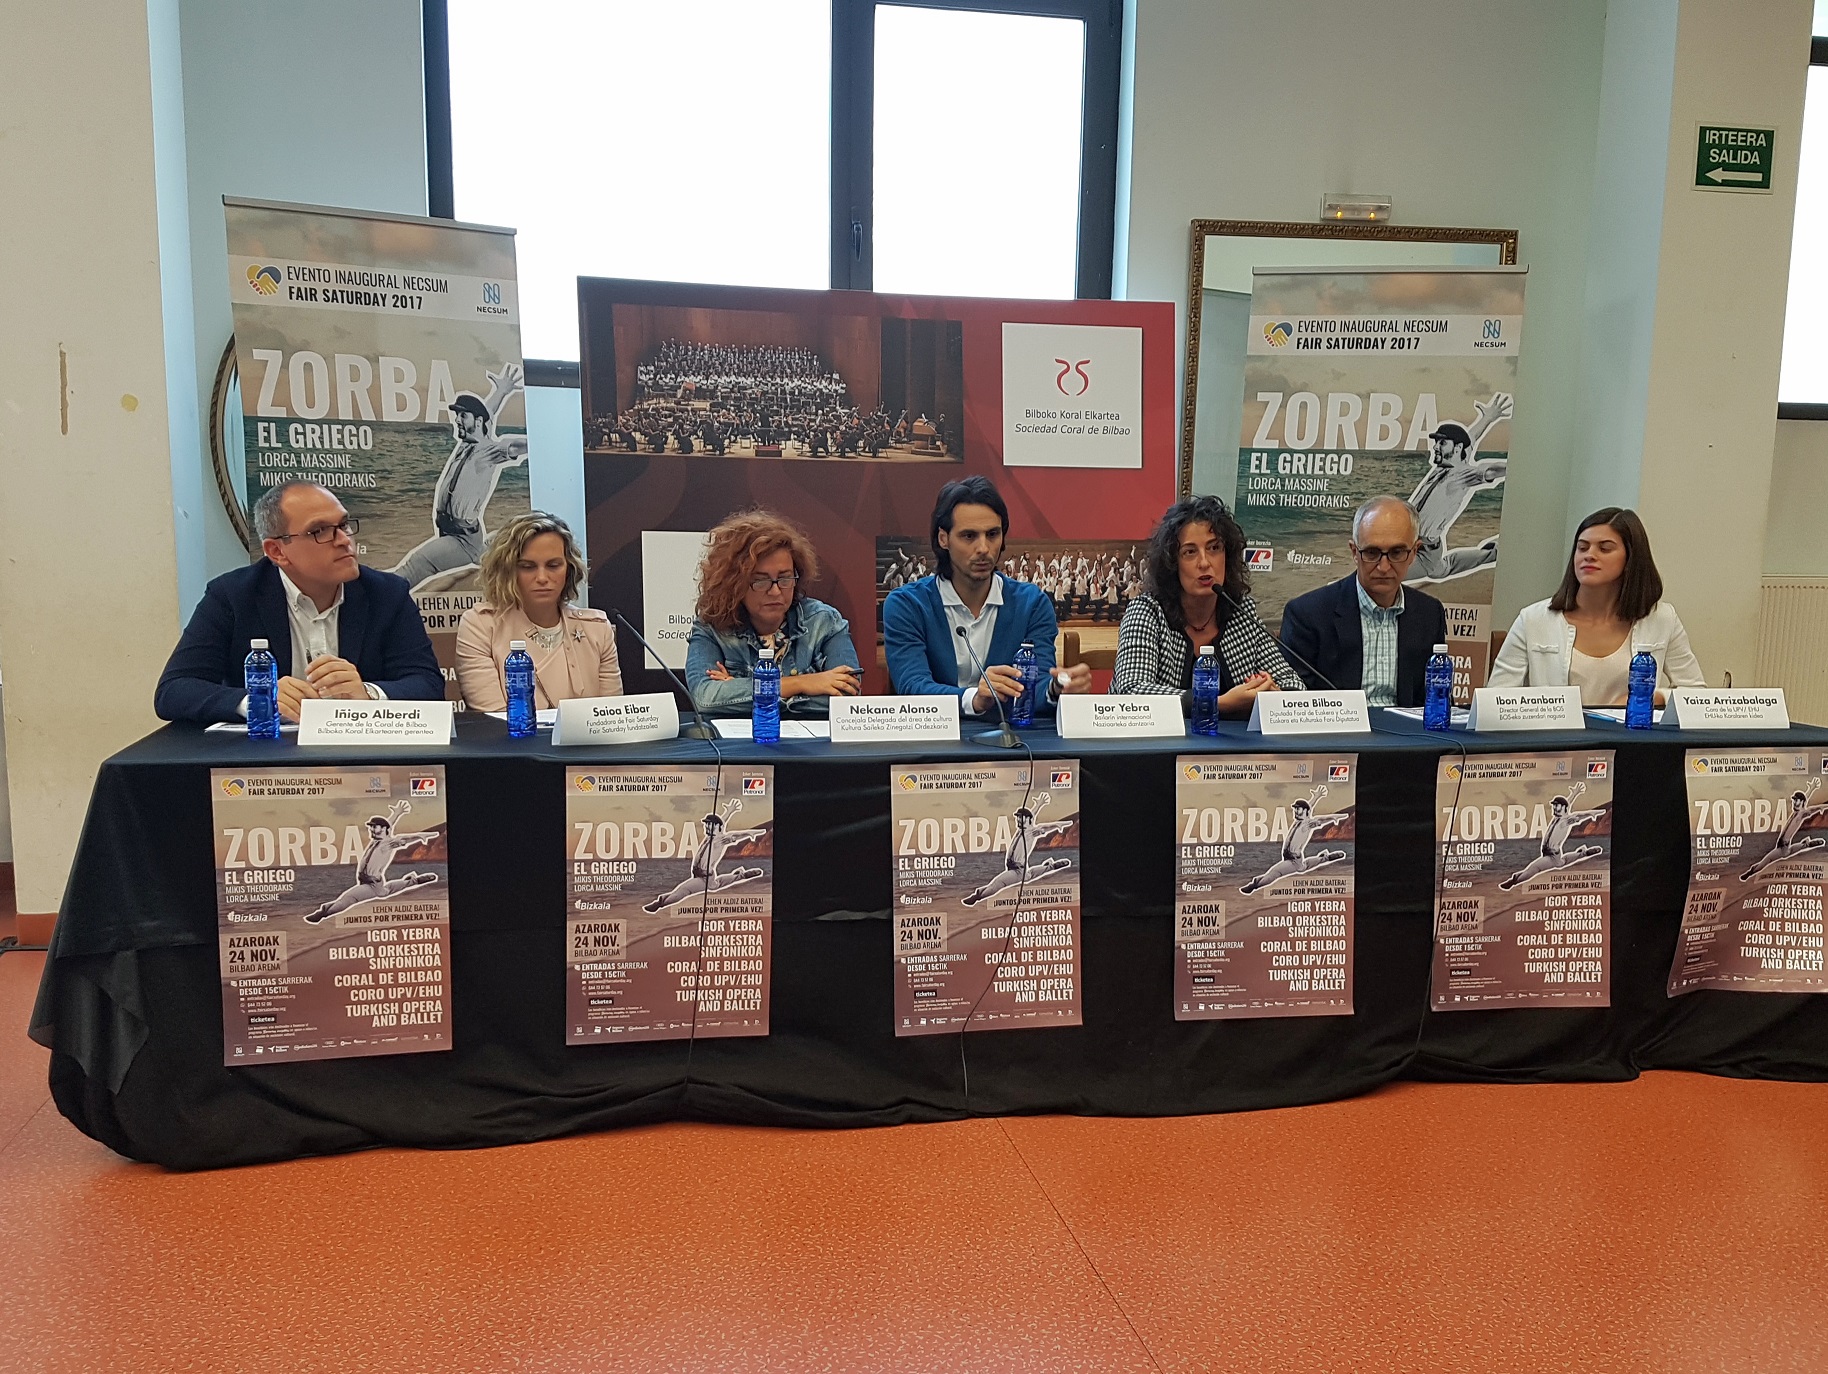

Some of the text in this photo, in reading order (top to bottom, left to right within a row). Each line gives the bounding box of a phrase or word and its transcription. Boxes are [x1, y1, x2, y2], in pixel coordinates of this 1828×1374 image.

[1705, 130, 1766, 147] IRTEERA
[1709, 149, 1760, 165] SALIDA
[287, 266, 449, 293] EVENTO INAUGURAL NECSUM
[289, 286, 423, 310] FAIR SATURDAY 2017
[477, 306, 508, 314] NECSUM
[1298, 320, 1448, 333] EVENTO INAUGURAL NECSUM
[1296, 338, 1420, 350] FAIR SATURDAY 2017
[252, 348, 458, 423] ZORBA
[1025, 409, 1120, 421] Bilboko Koral Elkartea
[1252, 392, 1440, 450] ZORBA
[258, 422, 372, 449] EL GRIEGO
[1015, 424, 1130, 435] Sociedad Coral de Bilbao
[259, 453, 352, 468] LORCA MASSINE
[1250, 452, 1353, 475] EL GRIEGO
[1248, 478, 1329, 491] LORCA MASSINE
[1248, 494, 1350, 508] MIKIS THEODORAKIS
[1294, 554, 1331, 565] Bizkaia
[417, 598, 450, 611] LEHEN
[668, 615, 694, 624] Bilbo
[1444, 608, 1478, 620] ATERA!
[422, 616, 445, 628] POR
[658, 630, 692, 639] Socied
[1453, 625, 1476, 636] VEZ!
[1282, 699, 1342, 708] Lorea Bilbao
[1496, 695, 1565, 705] Ibon Aranbarri
[1683, 696, 1777, 706] Yaiza Arrizabalaga
[593, 704, 650, 717] Saioa Eibar
[850, 704, 938, 714] Nekane Alonso
[1094, 703, 1150, 714] Igor Yebra
[334, 709, 420, 721] Iñigo Alberdi
[248, 788, 265, 796] FAIR
[1695, 799, 1791, 834] ZORBA
[1182, 807, 1289, 843] ZORBA
[574, 822, 700, 859] ZORBA
[899, 817, 1013, 855] ZORBA
[1710, 836, 1742, 848] GRIEGO
[223, 826, 365, 868] ZORBA
[1196, 845, 1234, 857] GRIEGO
[225, 869, 295, 884] EL GRIEGO
[1571, 895, 1602, 906] YEBRA
[1772, 898, 1822, 910] ORKESTRA
[392, 914, 423, 922] PRIMERA
[575, 923, 620, 933] AZAROAK
[729, 920, 763, 931] YEBRA
[1544, 920, 1602, 931] SINFONIKOA
[367, 928, 440, 942] IGOR YEBRA
[707, 935, 763, 946] ORKESTRA
[1445, 936, 1473, 944] ENTRADAS
[1745, 933, 1823, 947] CORO UPV/EHU
[229, 936, 279, 948] AZAROAK
[1261, 940, 1346, 952] CORAL DE BILBAO
[229, 949, 280, 963] 24 NOV.
[329, 943, 441, 960] BILBAO ORKESTRA
[369, 955, 441, 970] SINFONIKOA
[239, 976, 312, 987] ENTRADAS SARRERAK
[334, 970, 442, 987] CORAL DE BILBAO
[1567, 972, 1602, 983] BALLET
[993, 979, 1073, 992] TURKISH OPERA
[350, 985, 442, 1001] CORO UPV/EHU
[345, 1000, 442, 1017] TURKISH OPERA
[372, 1012, 442, 1027] AND BALLET
